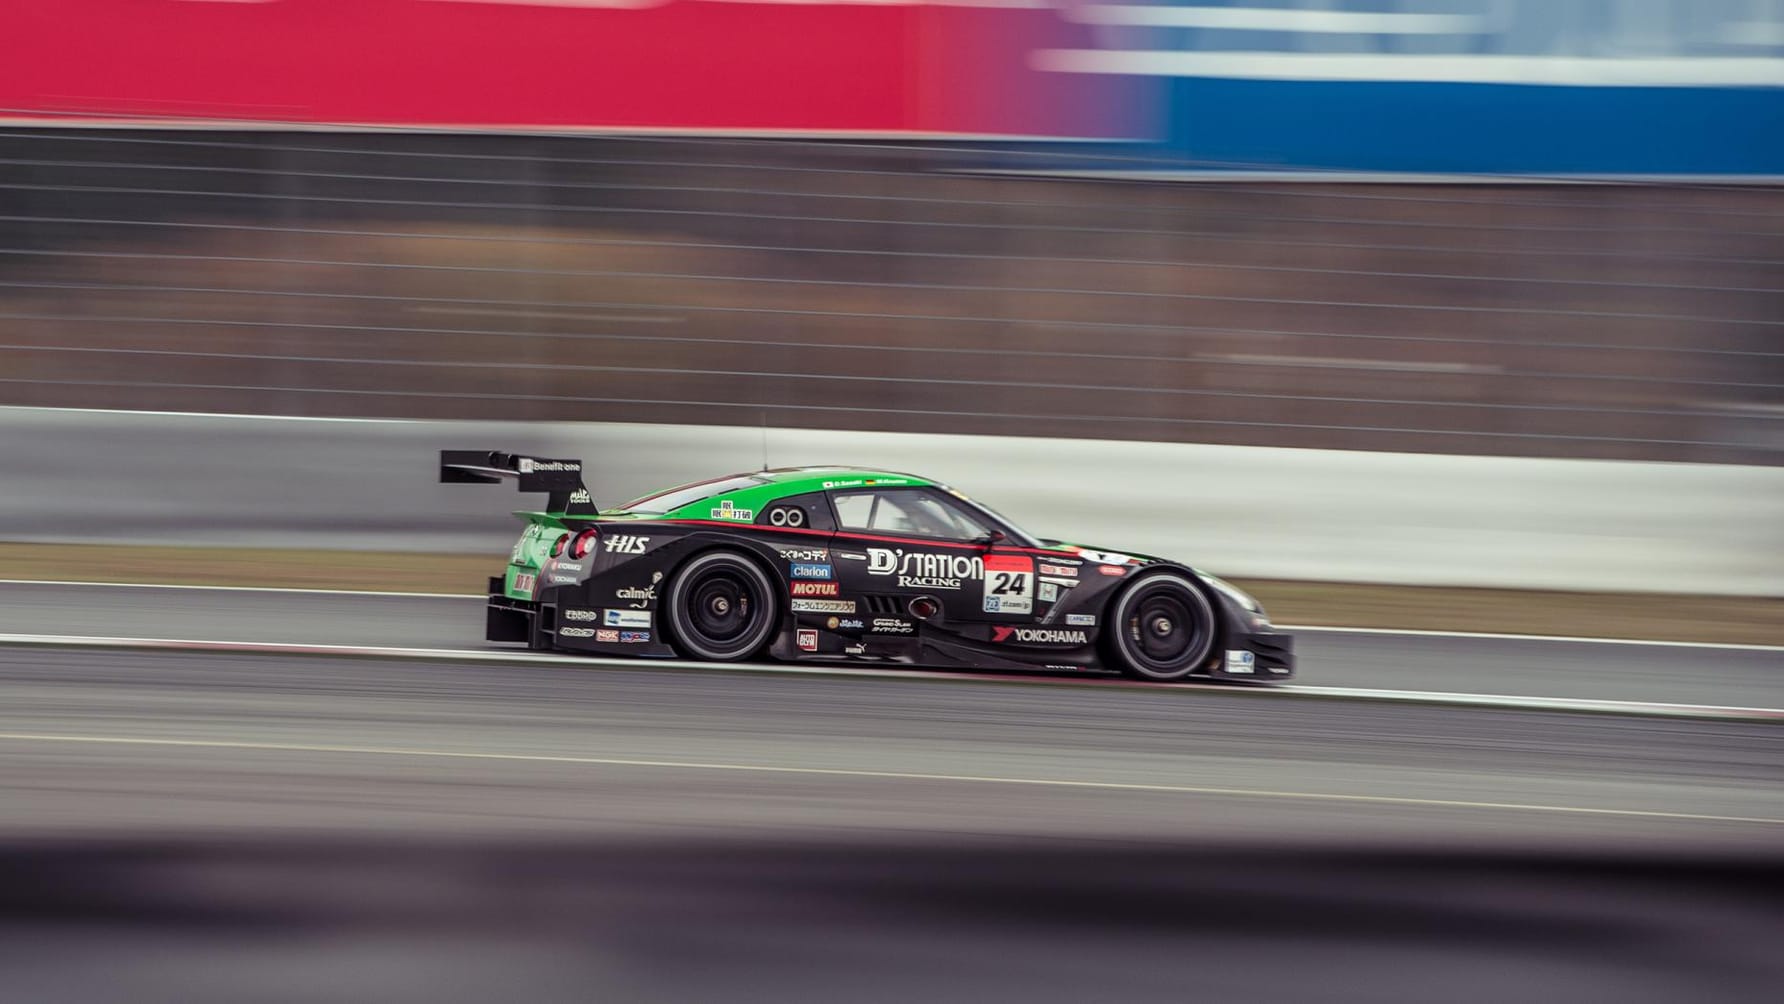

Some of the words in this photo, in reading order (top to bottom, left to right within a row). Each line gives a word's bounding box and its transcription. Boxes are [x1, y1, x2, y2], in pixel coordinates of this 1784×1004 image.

[793, 583, 838, 596] MOTUL
[898, 576, 961, 589] RACING
[991, 572, 1026, 596] 24
[1014, 628, 1088, 644] YOKOHAMA
